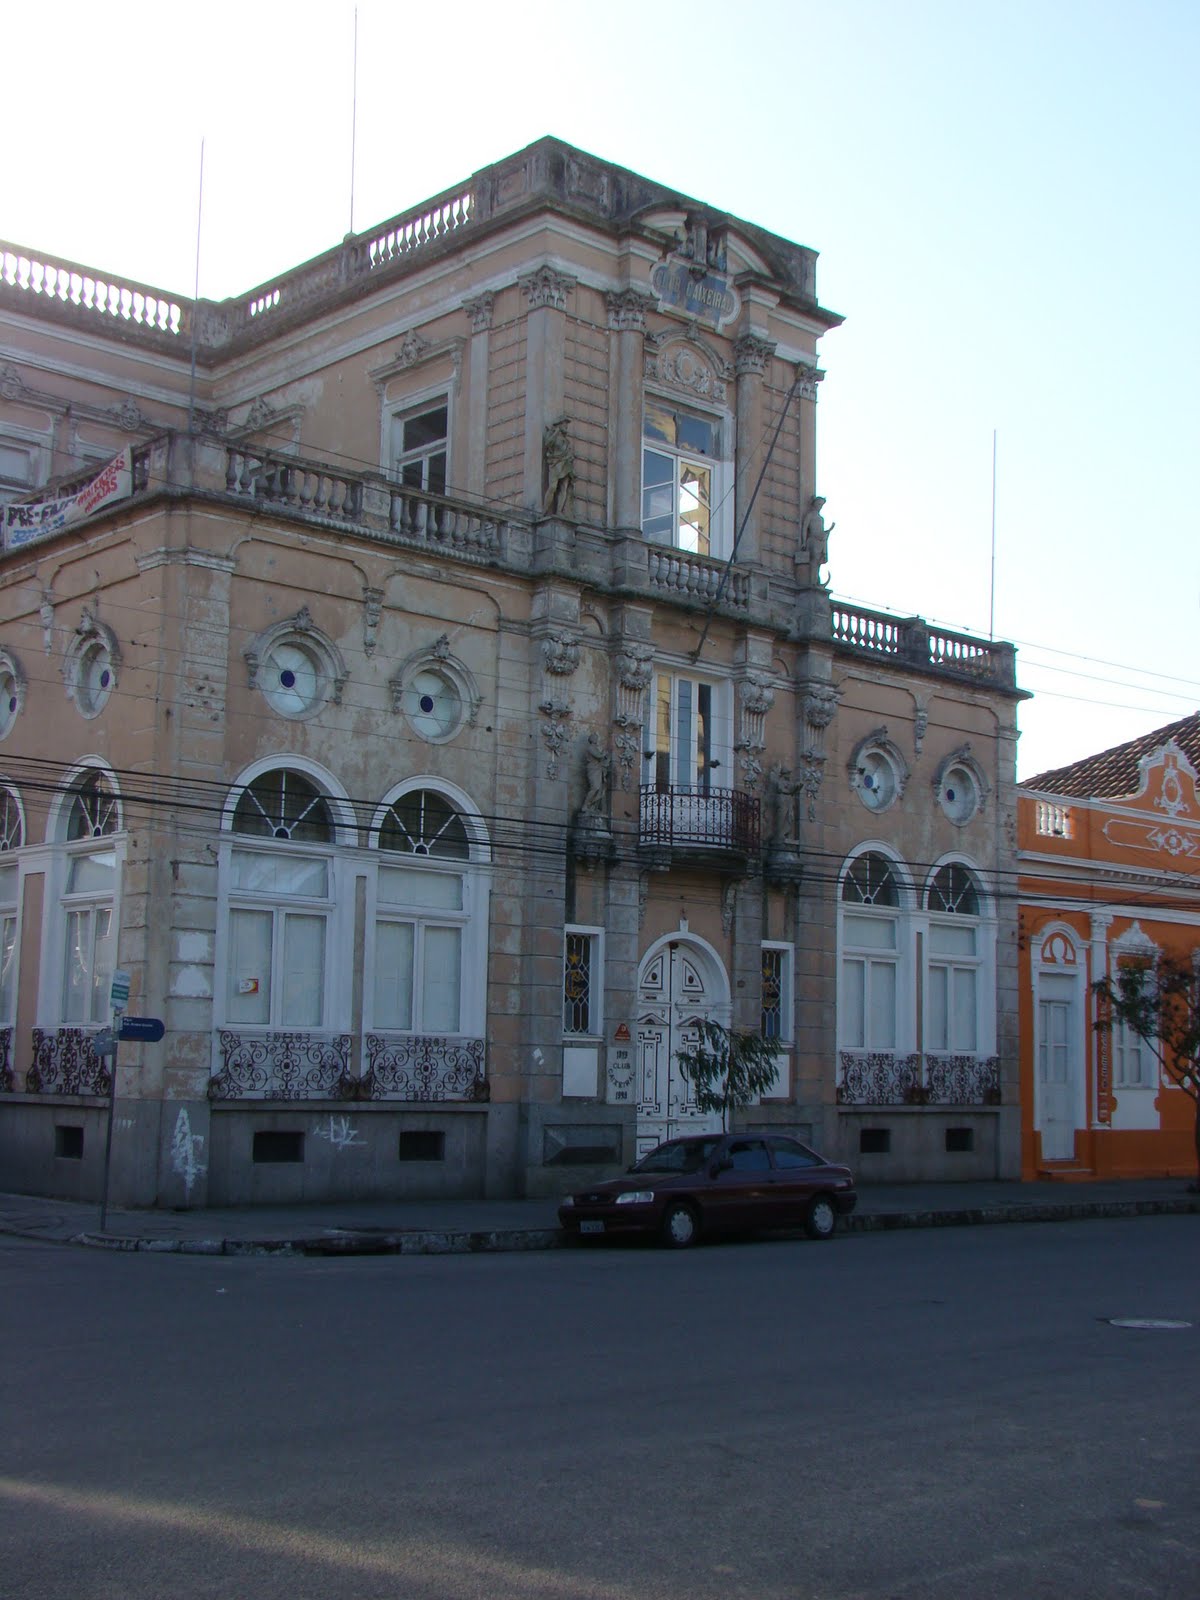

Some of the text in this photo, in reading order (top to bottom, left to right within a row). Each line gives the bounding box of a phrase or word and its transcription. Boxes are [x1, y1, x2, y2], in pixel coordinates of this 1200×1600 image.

[653, 269, 733, 313] CLUB CAIXEIRAL
[612, 1062, 631, 1070] CLUB
